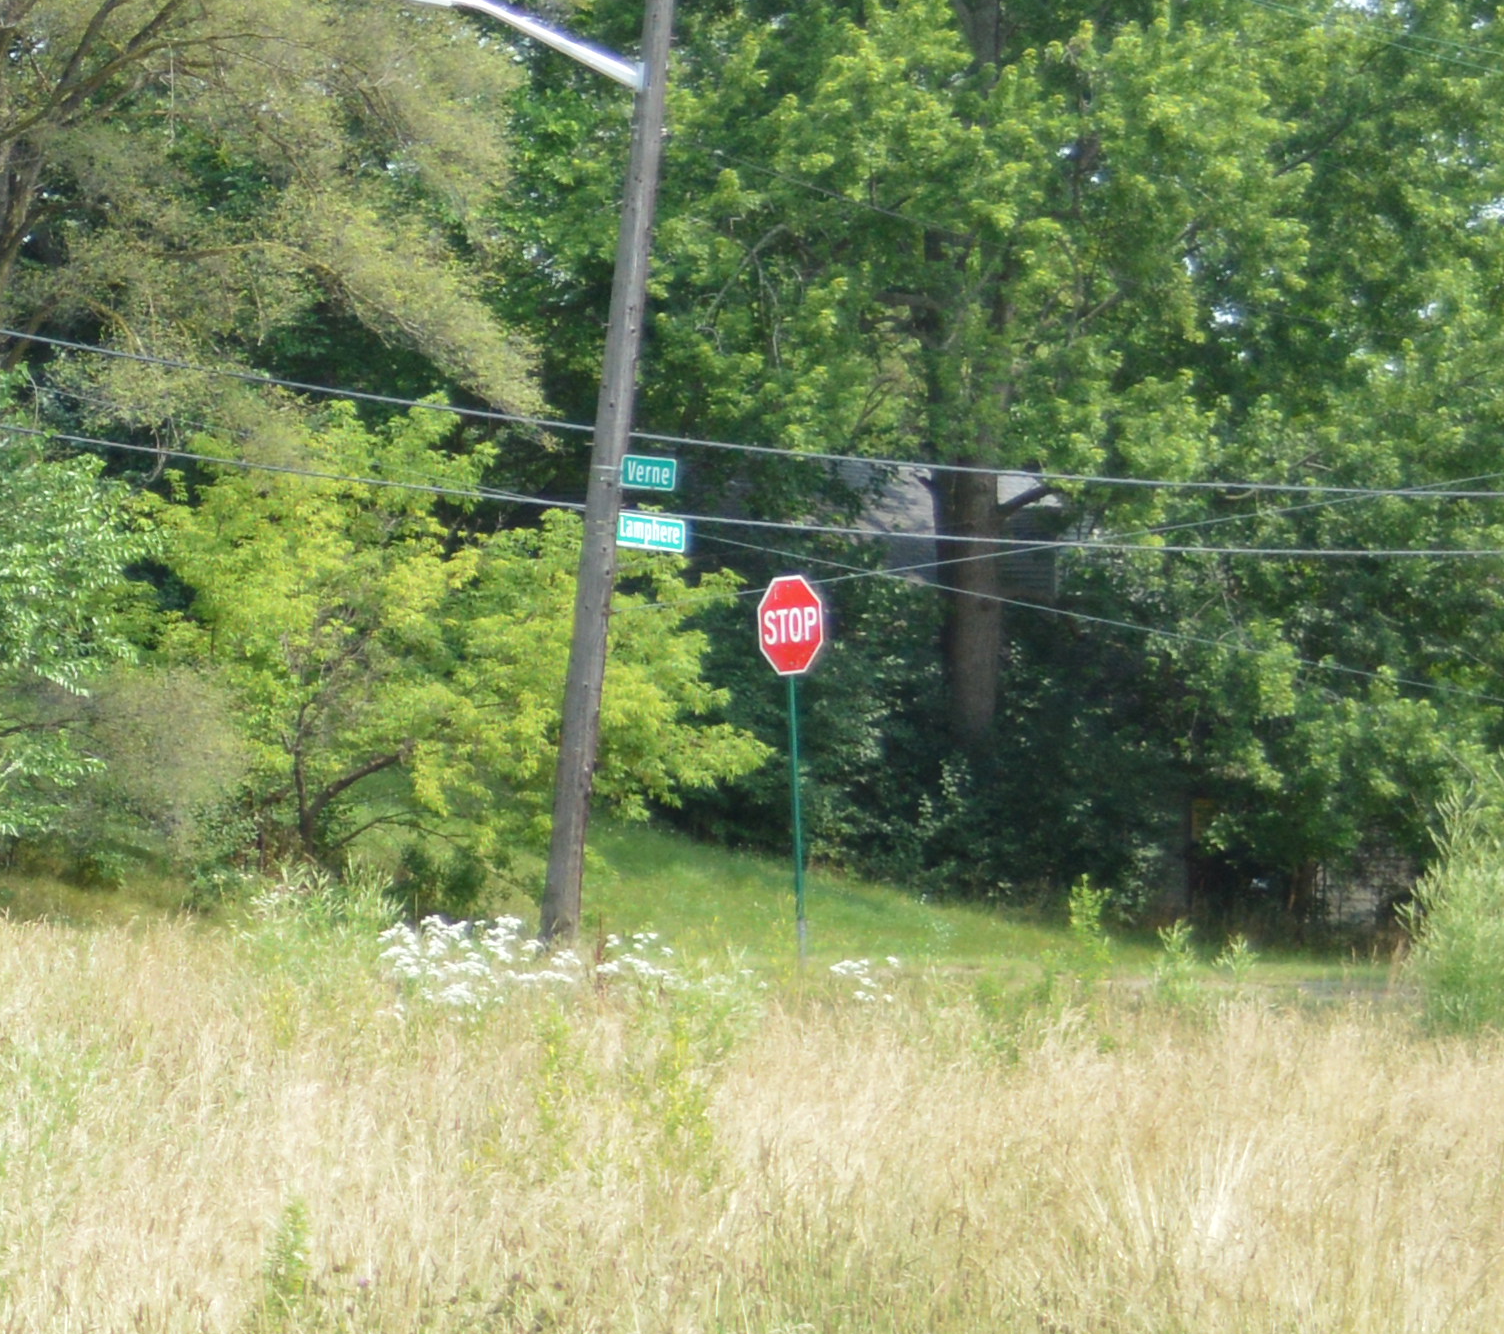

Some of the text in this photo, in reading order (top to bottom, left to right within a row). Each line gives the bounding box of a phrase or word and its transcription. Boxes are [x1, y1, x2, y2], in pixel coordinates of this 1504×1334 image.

[628, 460, 670, 485] Verne
[619, 516, 681, 545] Lamphere
[764, 606, 817, 645] STOP
